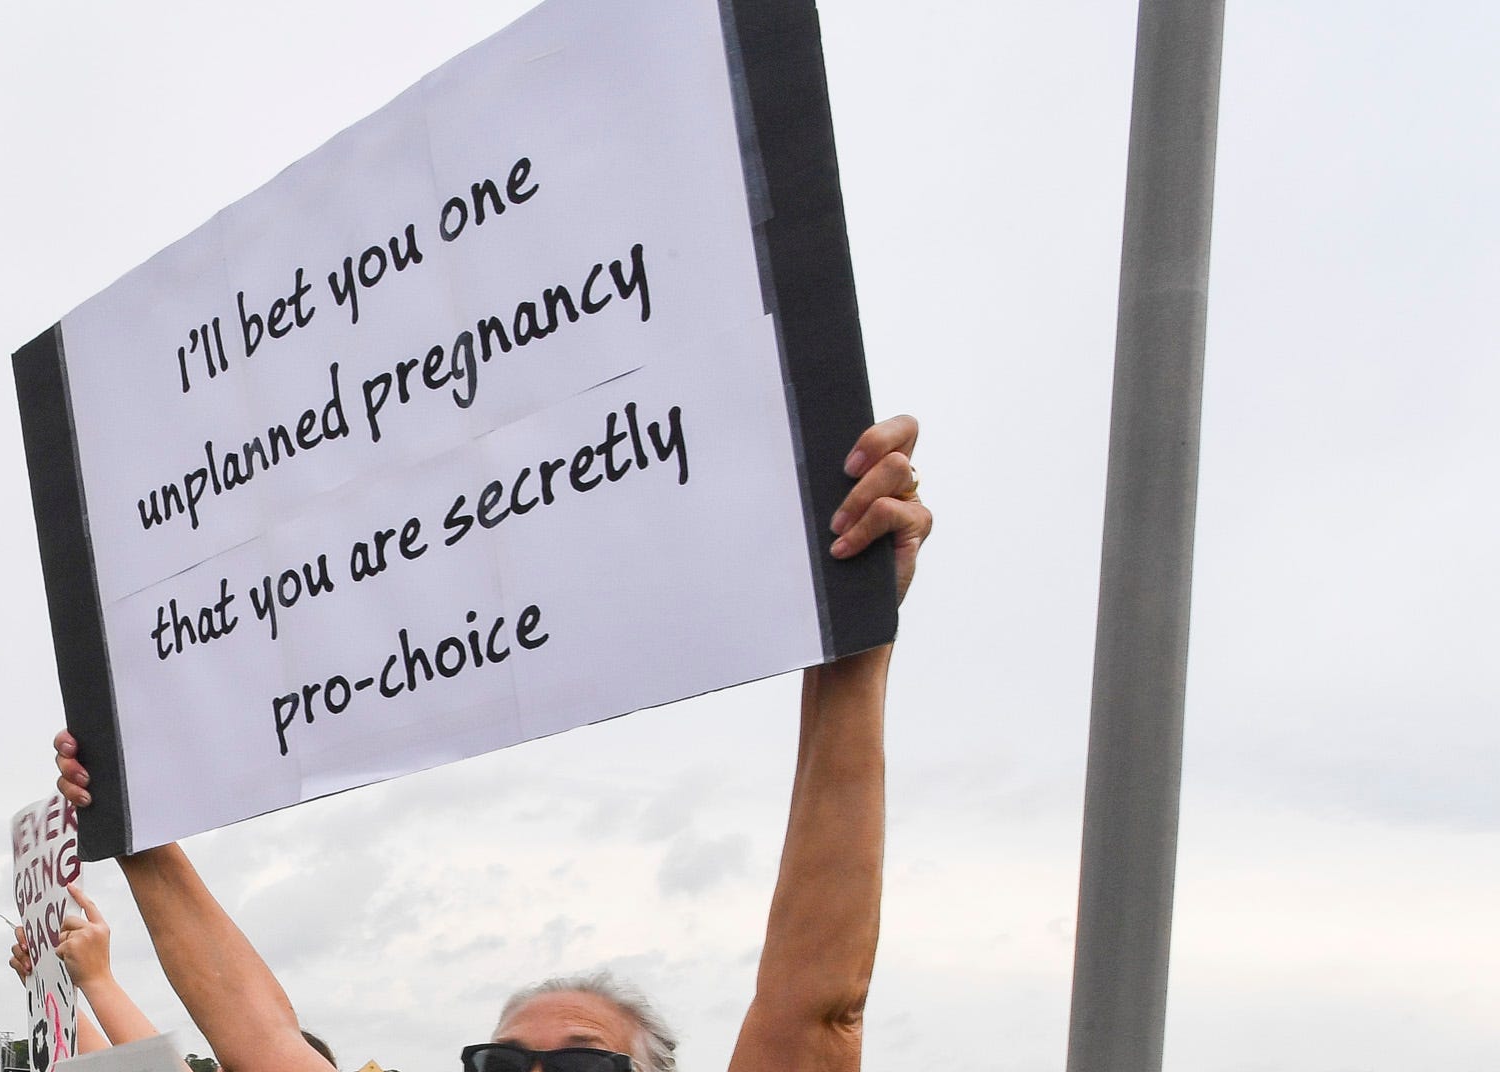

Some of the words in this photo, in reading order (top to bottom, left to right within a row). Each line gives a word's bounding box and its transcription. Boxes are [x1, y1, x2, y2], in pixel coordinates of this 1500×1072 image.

[177, 316, 229, 394] I'll
[236, 267, 316, 358] bet
[327, 223, 424, 325] you
[439, 157, 540, 243] one
[137, 361, 350, 531] unplanned
[362, 243, 651, 443] pregnancy
[150, 578, 239, 661] that
[249, 553, 335, 641] you
[350, 517, 429, 582] are
[443, 401, 689, 547] secretly
[272, 604, 550, 757] pro-choice
[15, 838, 81, 918] GOING
[25, 897, 67, 967] BACK
